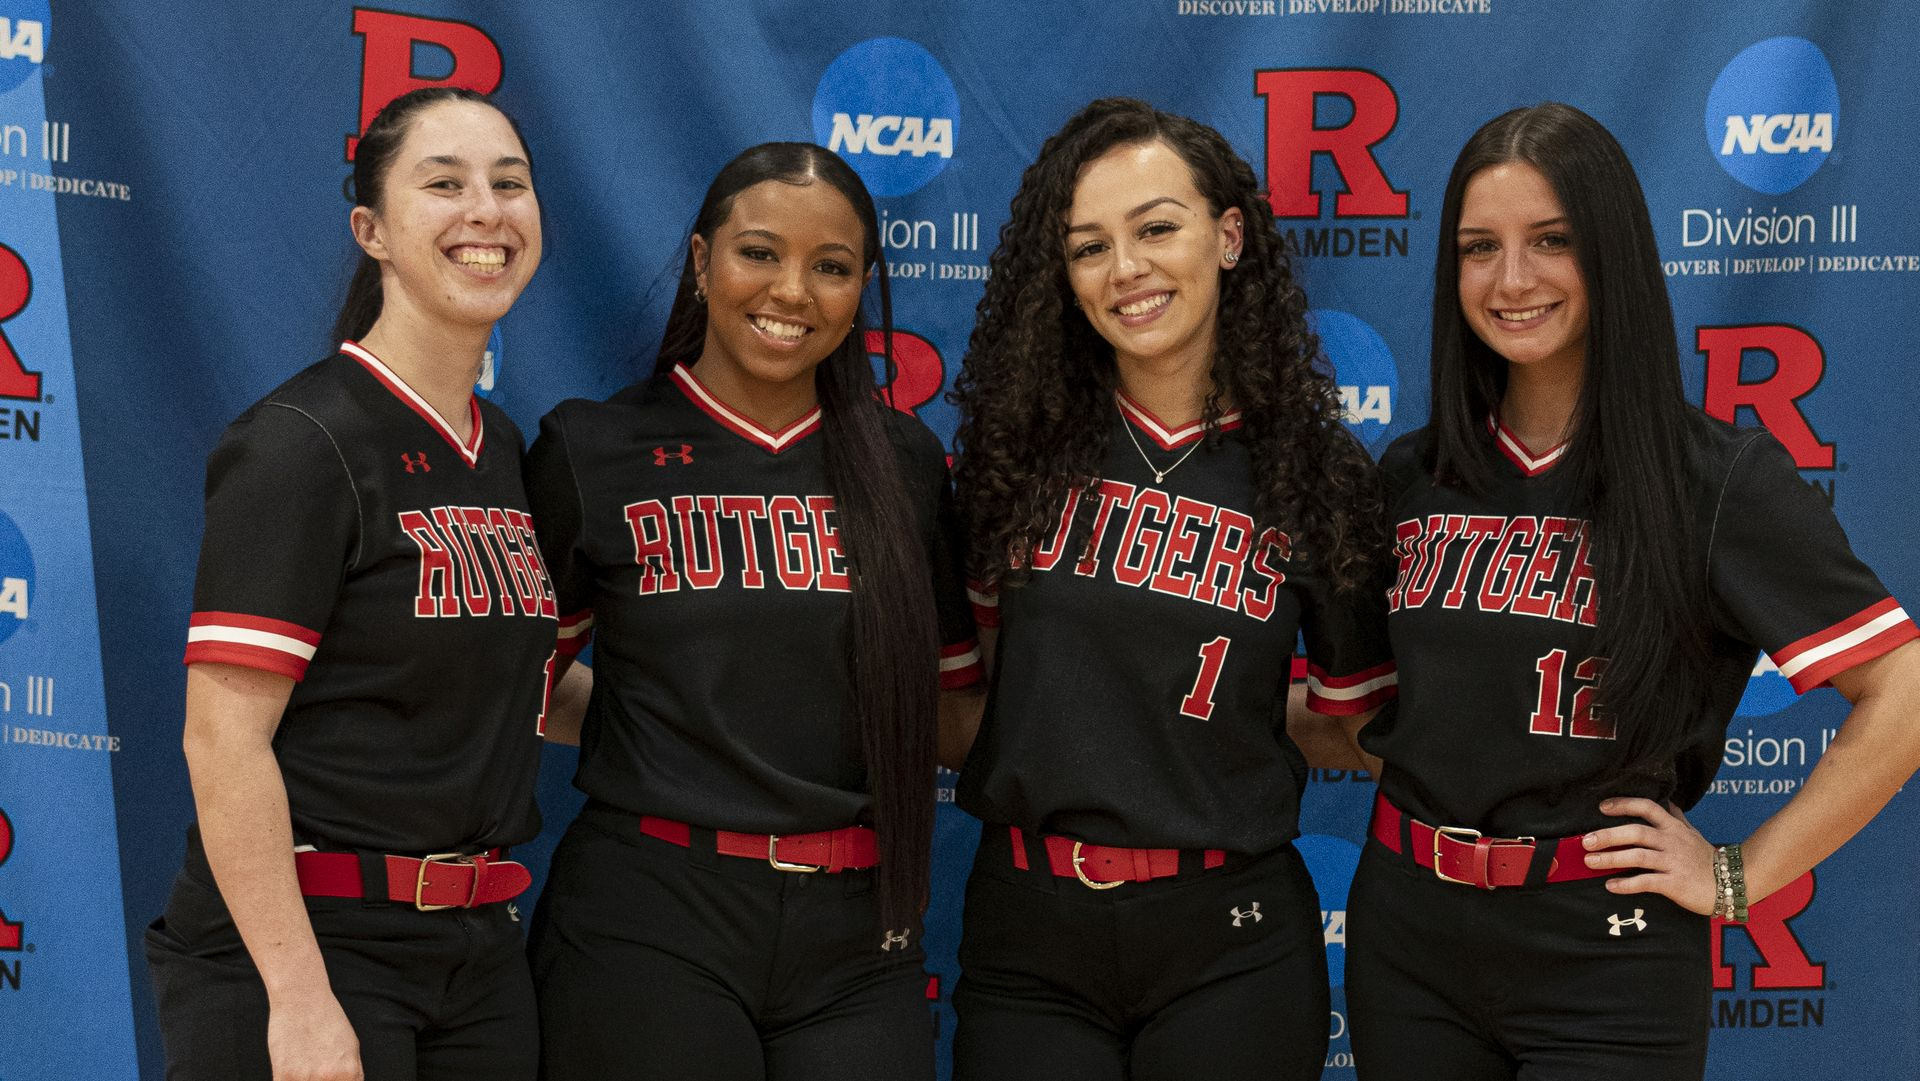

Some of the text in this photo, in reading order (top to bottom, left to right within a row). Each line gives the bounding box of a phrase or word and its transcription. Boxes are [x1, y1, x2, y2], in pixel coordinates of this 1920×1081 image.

[1178, 0, 1492, 15] DISCOVER DEVELOP DEDICATE
[828, 112, 953, 158] NCAA
[1253, 66, 1410, 220] R
[1721, 112, 1833, 155] NCAA
[30, 172, 131, 200] DEDICATE
[1284, 227, 1409, 257] AMDEN
[1682, 205, 1857, 247] Division III
[1733, 256, 1805, 274] DEVELOP
[1818, 255, 1919, 272] DEDICATE
[1695, 322, 1836, 471] R
[398, 506, 560, 620] RUTGE
[624, 495, 853, 595] RUTGE
[1011, 478, 1292, 622] UTGERS
[1386, 514, 1600, 627] RUTGER
[1180, 635, 1231, 721] 1
[1529, 648, 1617, 740] 12
[13, 727, 121, 752] DEDICATE
[1711, 998, 1825, 1028] MDEN
